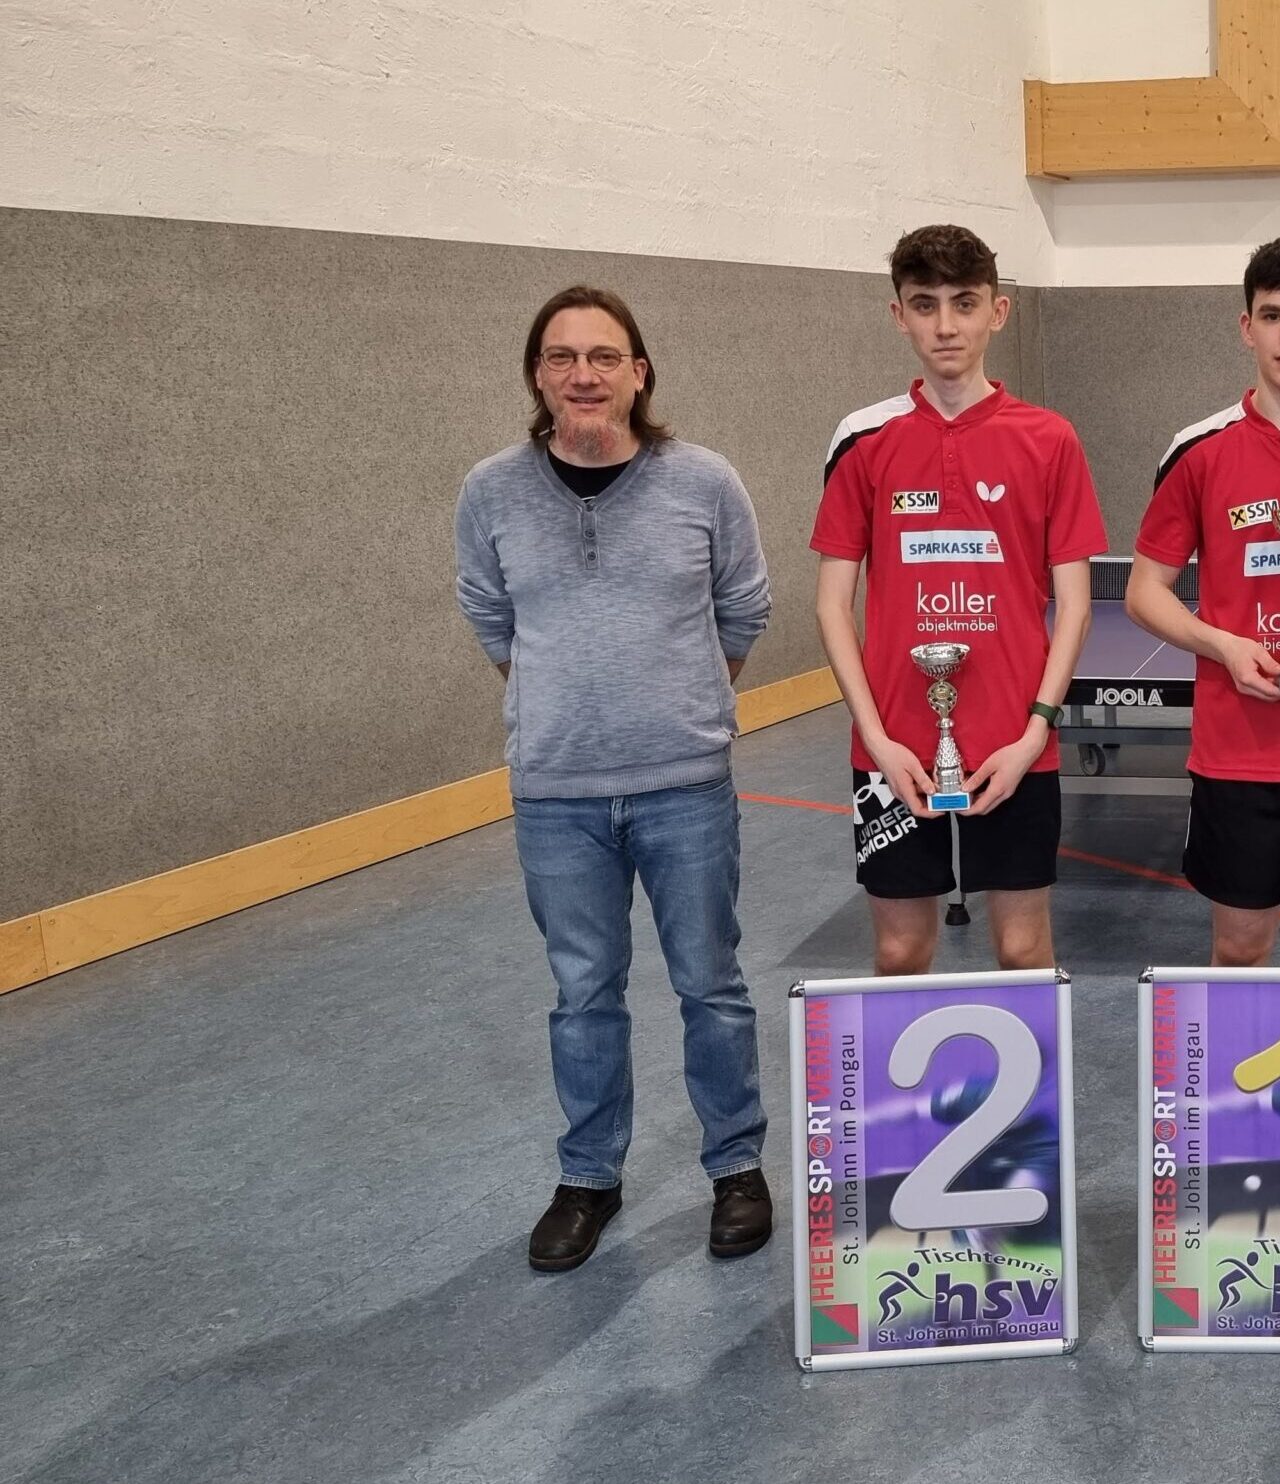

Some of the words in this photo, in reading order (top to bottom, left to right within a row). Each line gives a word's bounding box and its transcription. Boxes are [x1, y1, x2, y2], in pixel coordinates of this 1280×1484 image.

[907, 492, 938, 507] SSM
[1247, 500, 1278, 519] SSM
[909, 542, 984, 555] SPARKASSE
[917, 582, 996, 613] koller
[917, 617, 998, 635] objektmöbel
[1095, 688, 1163, 706] JOOLA
[857, 816, 918, 866] ARMOUR
[840, 1034, 859, 1111] Pongau
[1185, 1022, 1203, 1097] Pongau
[888, 1004, 1048, 1231] 2
[1184, 1107, 1200, 1130] im
[840, 1120, 856, 1144] im
[1183, 1140, 1200, 1213] Johann
[840, 1154, 858, 1227] Johann
[1185, 1222, 1200, 1249] St.
[843, 1237, 858, 1264] St.
[914, 1248, 1055, 1277] Tischtennis
[934, 1273, 1058, 1323] hsv
[878, 1330, 900, 1343] St.
[906, 1325, 967, 1341] Johann
[972, 1324, 992, 1336] im
[998, 1321, 1060, 1335] Pongau
[1217, 1317, 1239, 1329] St.
